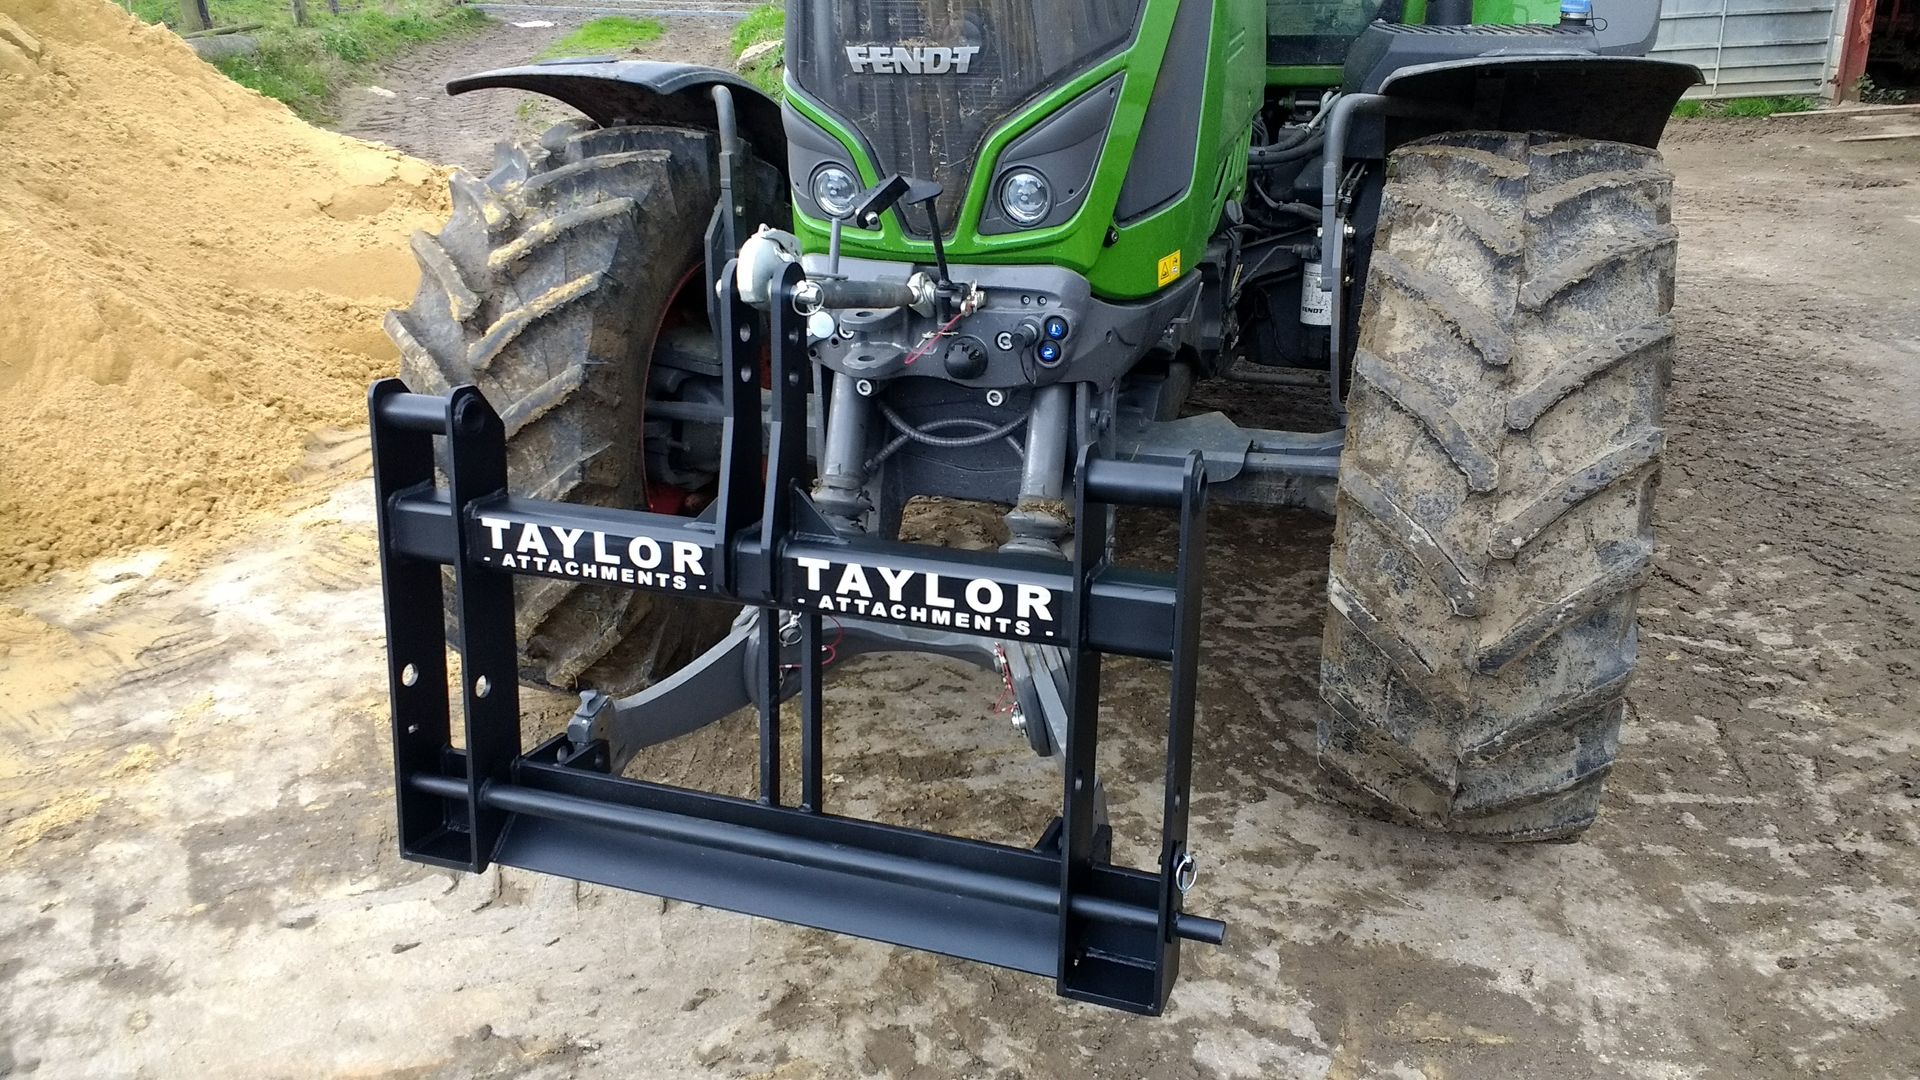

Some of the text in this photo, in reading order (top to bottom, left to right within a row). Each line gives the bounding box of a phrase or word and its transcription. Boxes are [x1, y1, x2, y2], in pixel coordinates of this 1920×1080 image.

[846, 46, 980, 74] FENDT
[482, 517, 706, 576] TAYLOR
[502, 553, 687, 590] ATTACHMENTS
[797, 556, 1053, 621] TAYLOR
[818, 595, 1031, 636] ATTACHMENTS
